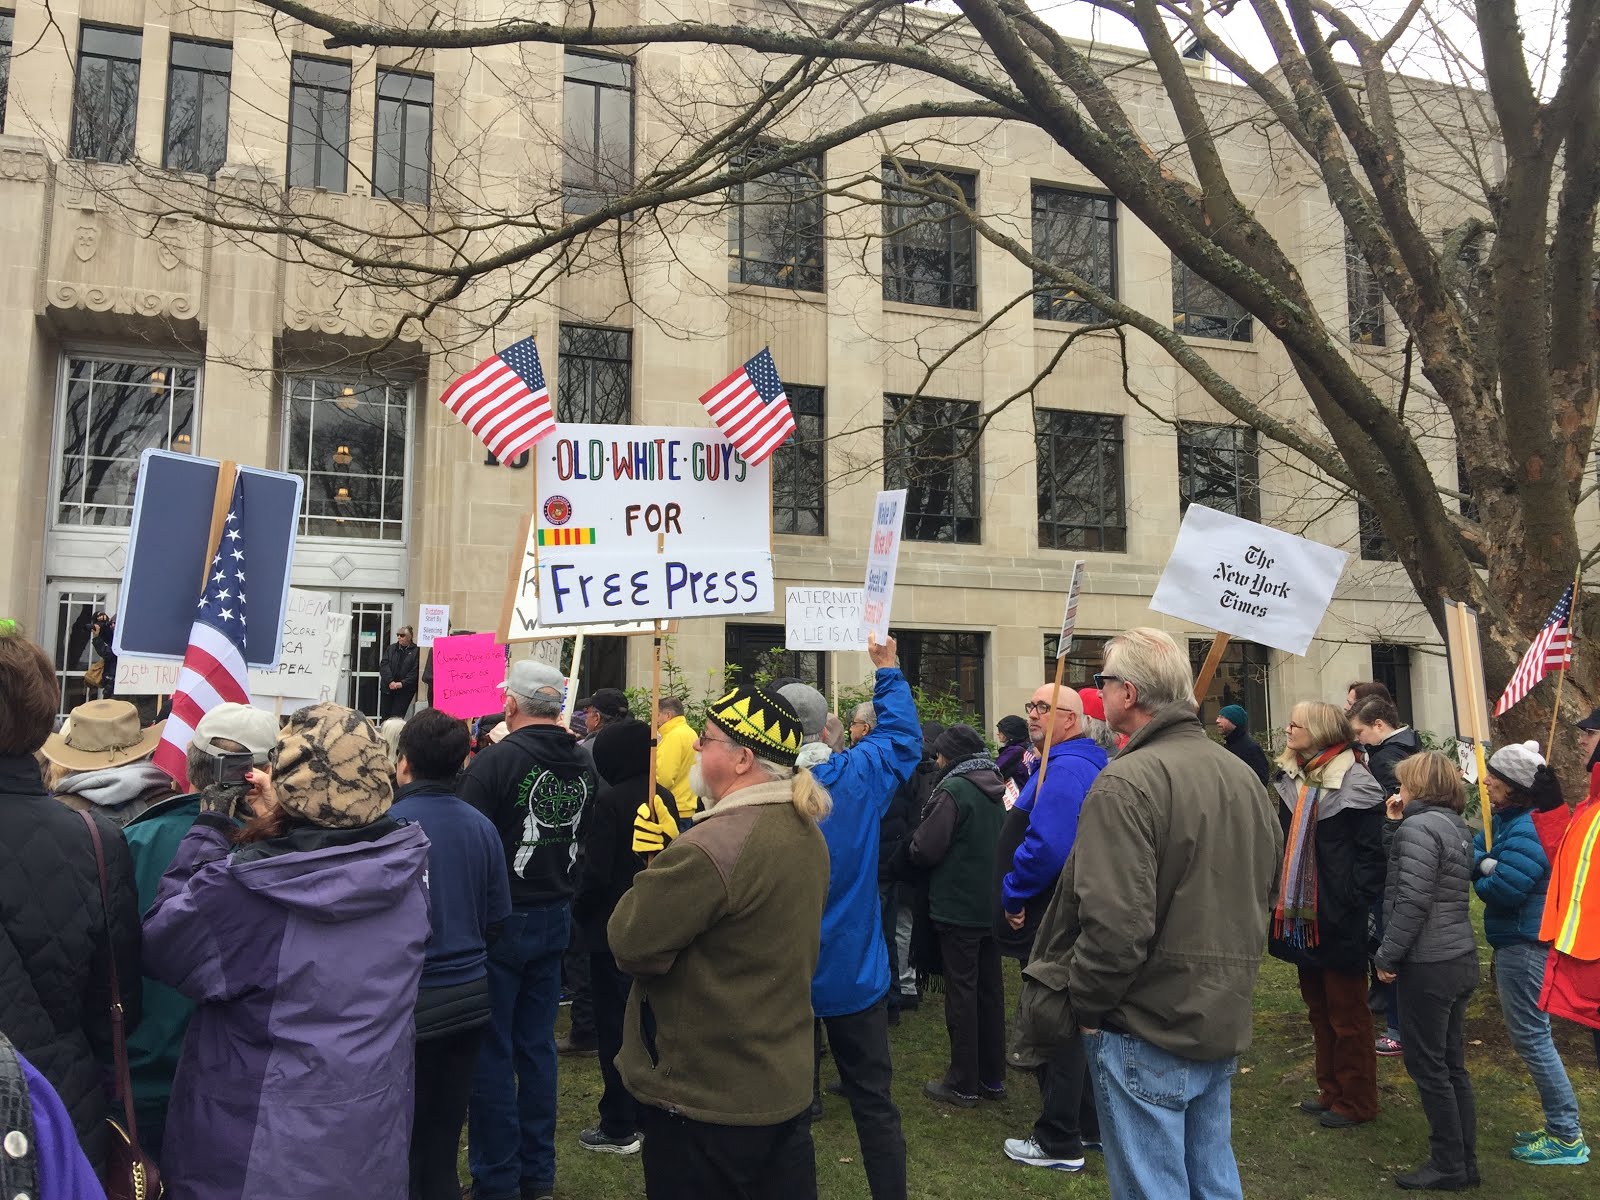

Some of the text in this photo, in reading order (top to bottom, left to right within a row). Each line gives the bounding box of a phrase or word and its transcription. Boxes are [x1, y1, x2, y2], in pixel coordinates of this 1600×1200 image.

[556, 439, 604, 481] OLD
[611, 439, 681, 481] WHITE
[692, 441, 747, 482] GUYS
[625, 502, 682, 537] FOR
[1244, 545, 1275, 569] The
[1213, 562, 1291, 599] New York
[788, 590, 863, 605] ALTERNATI
[1219, 589, 1269, 618] Times
[804, 626, 823, 641] LIE
[829, 627, 840, 642] IS
[118, 664, 180, 685] 25th TRU
